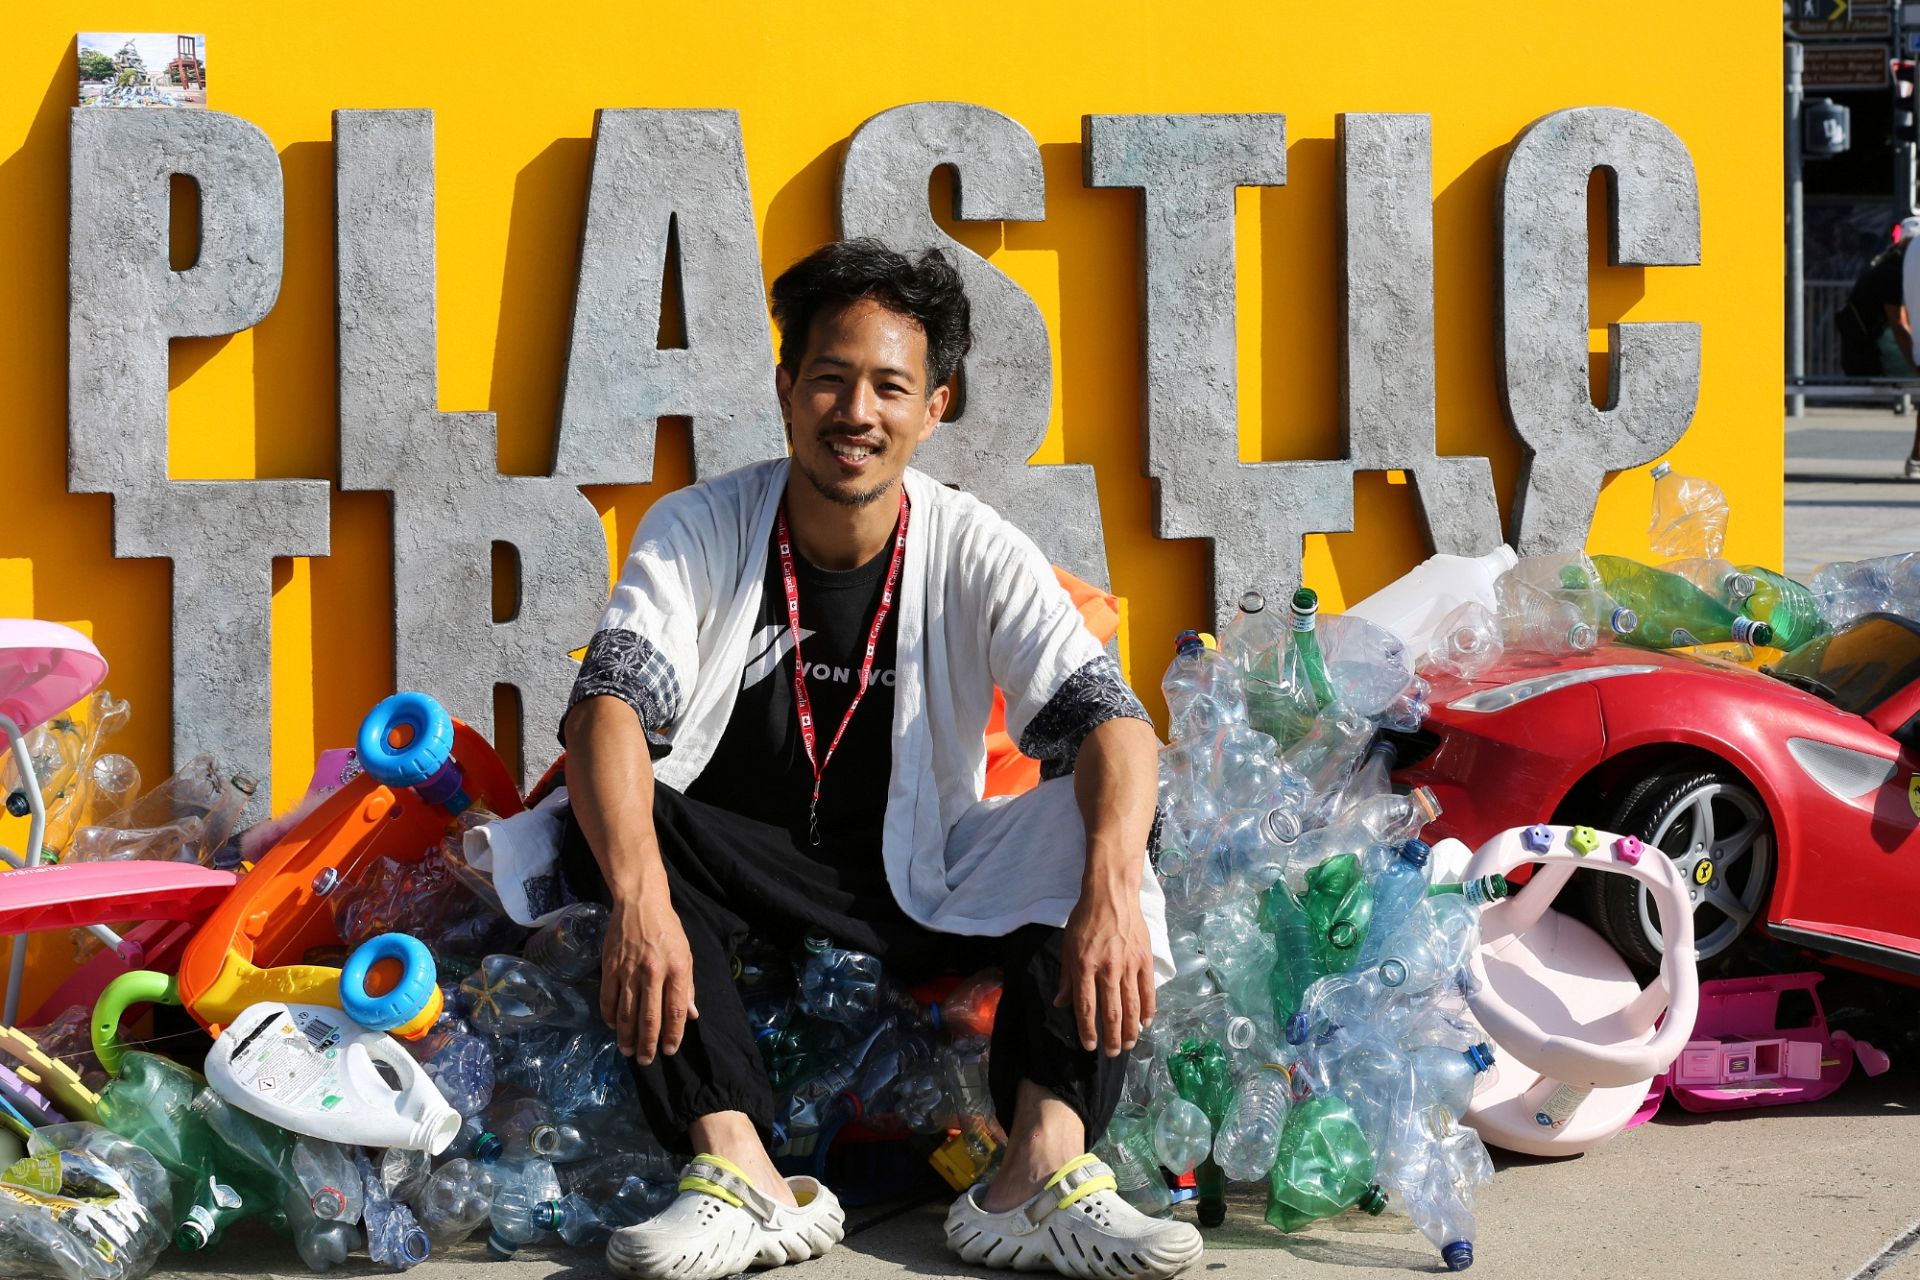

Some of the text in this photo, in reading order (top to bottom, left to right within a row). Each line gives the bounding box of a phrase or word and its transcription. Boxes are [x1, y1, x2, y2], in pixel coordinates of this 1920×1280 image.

[68, 100, 1702, 495] PLASTIC
[111, 457, 1608, 838] TRT
[783, 561, 793, 593] Canada
[795, 677, 806, 708] Canada
[861, 664, 871, 695] Canada
[870, 610, 888, 639] Canada
[888, 556, 902, 586] Canada
